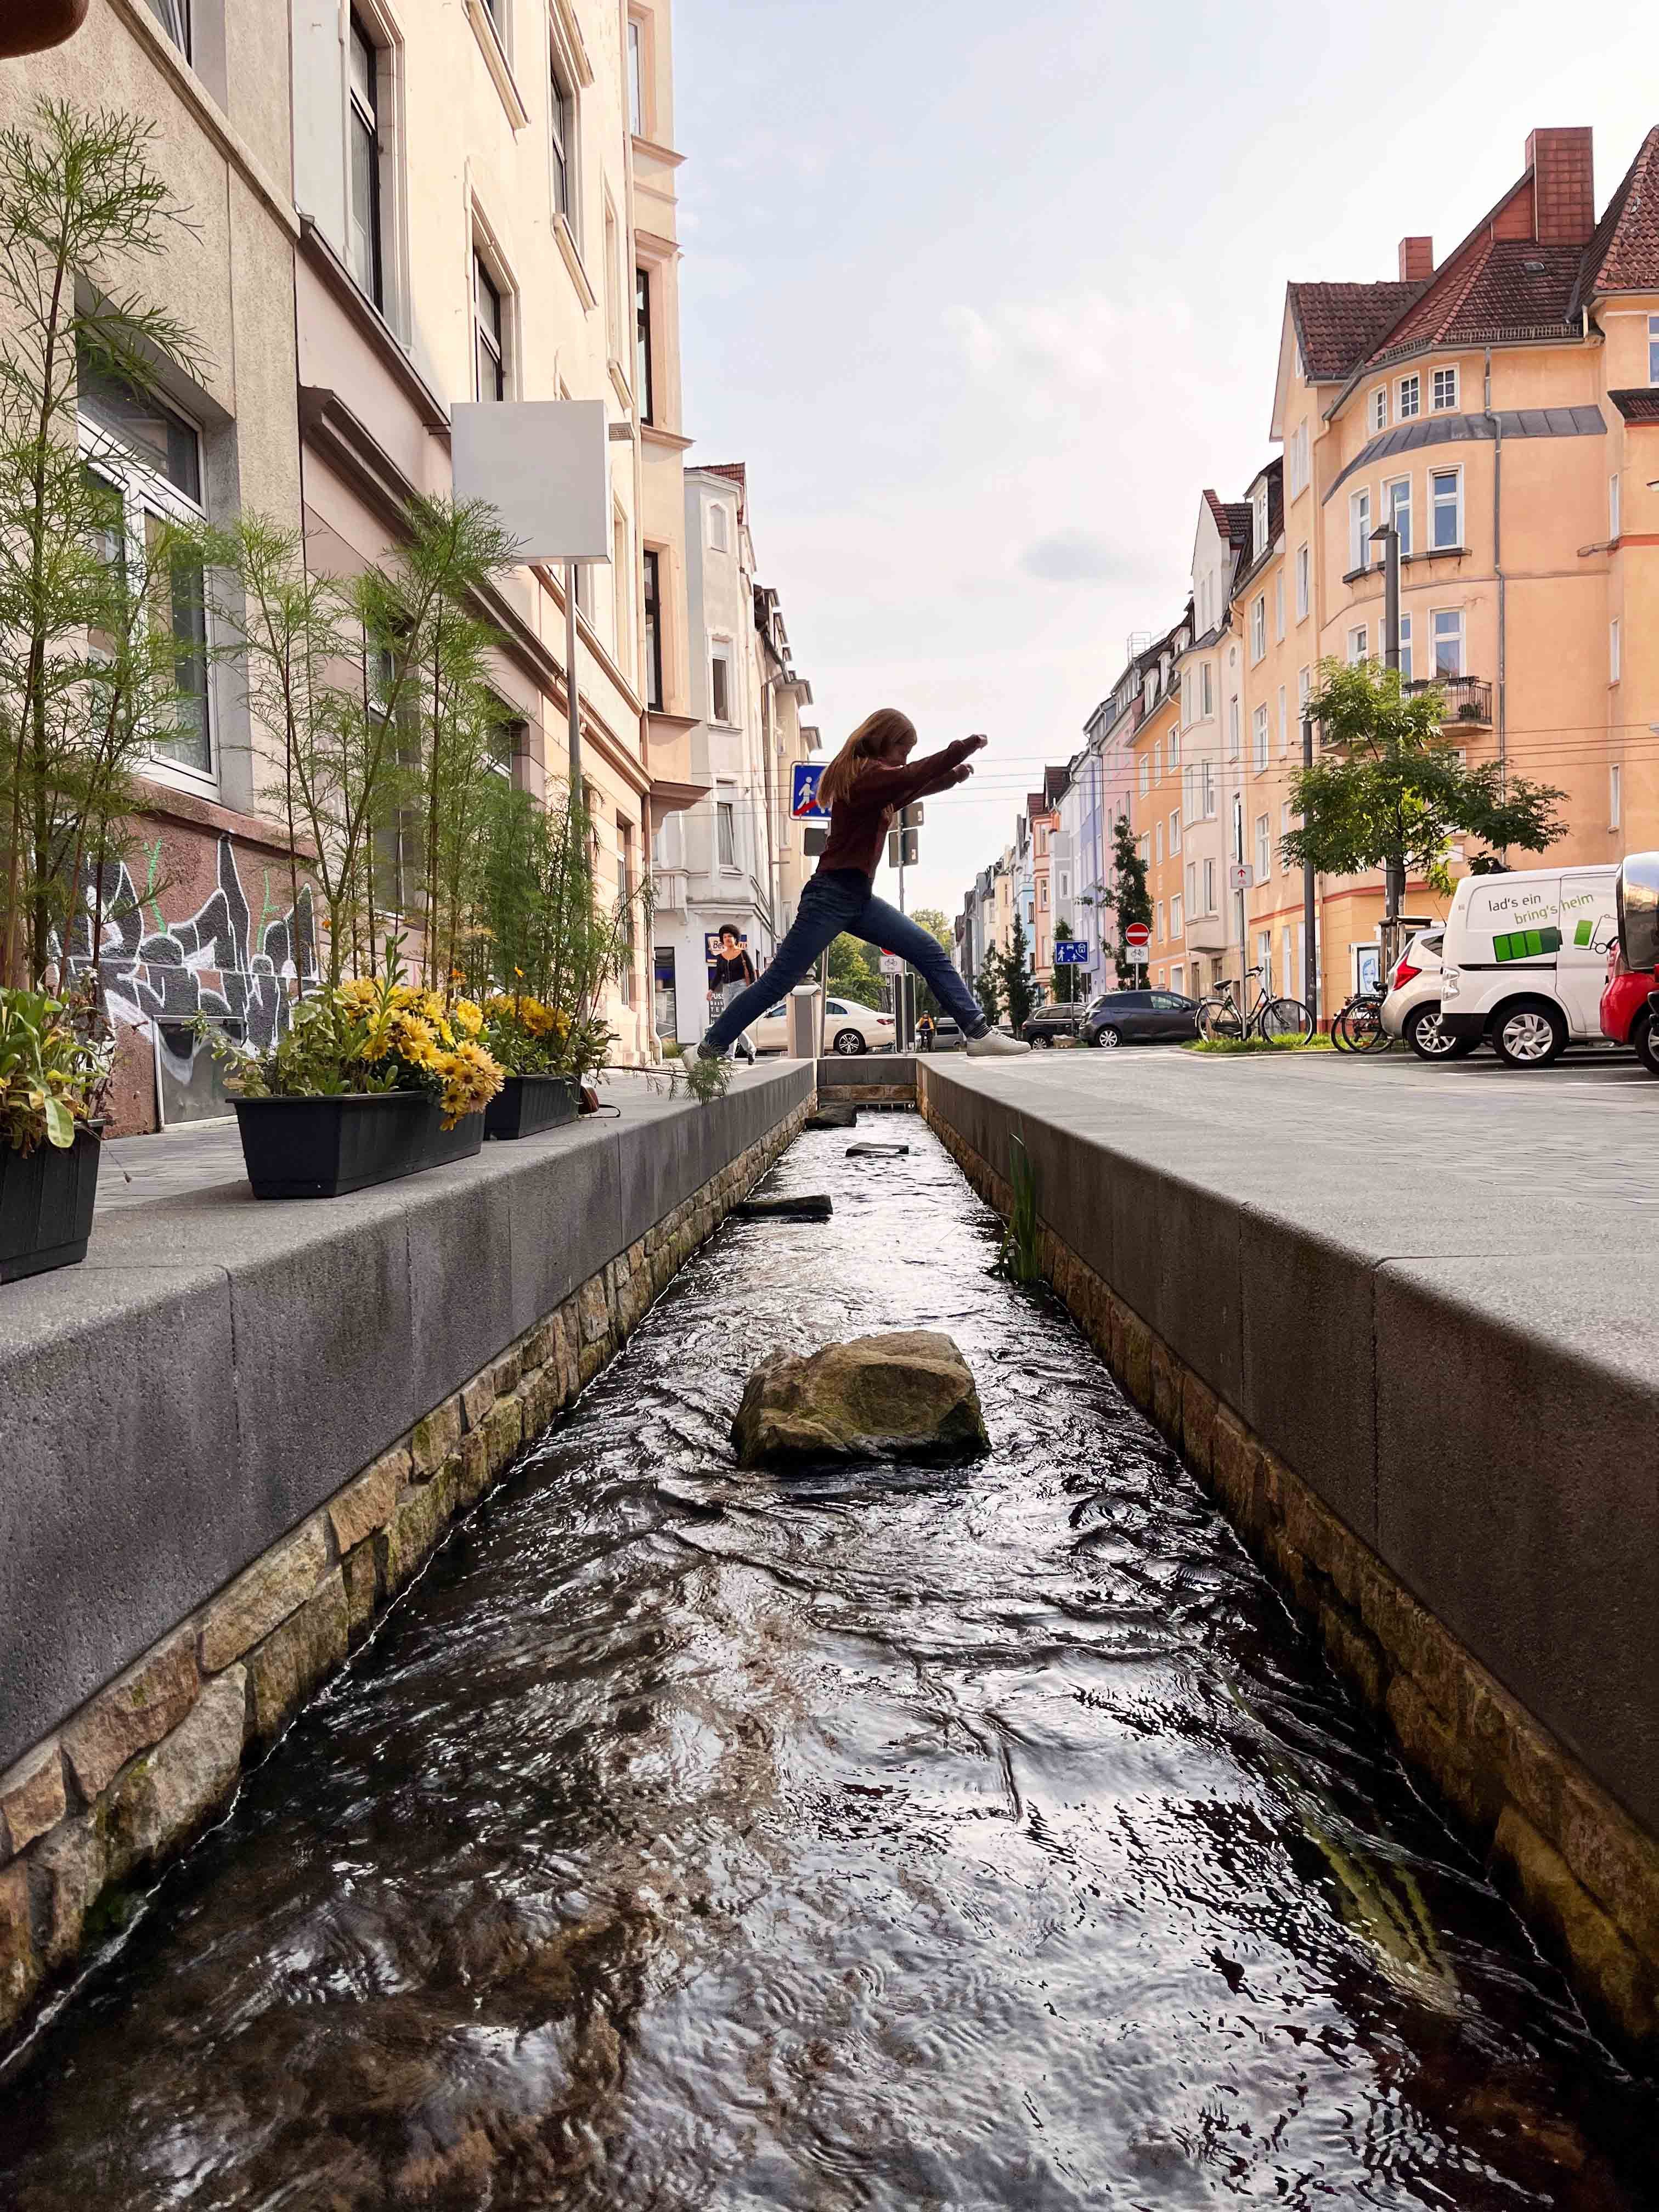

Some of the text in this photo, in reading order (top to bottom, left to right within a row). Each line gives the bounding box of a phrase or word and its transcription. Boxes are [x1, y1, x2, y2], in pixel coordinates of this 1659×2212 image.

[1488, 894, 1541, 912] lad's ein
[1514, 894, 1594, 924] bring's heim
